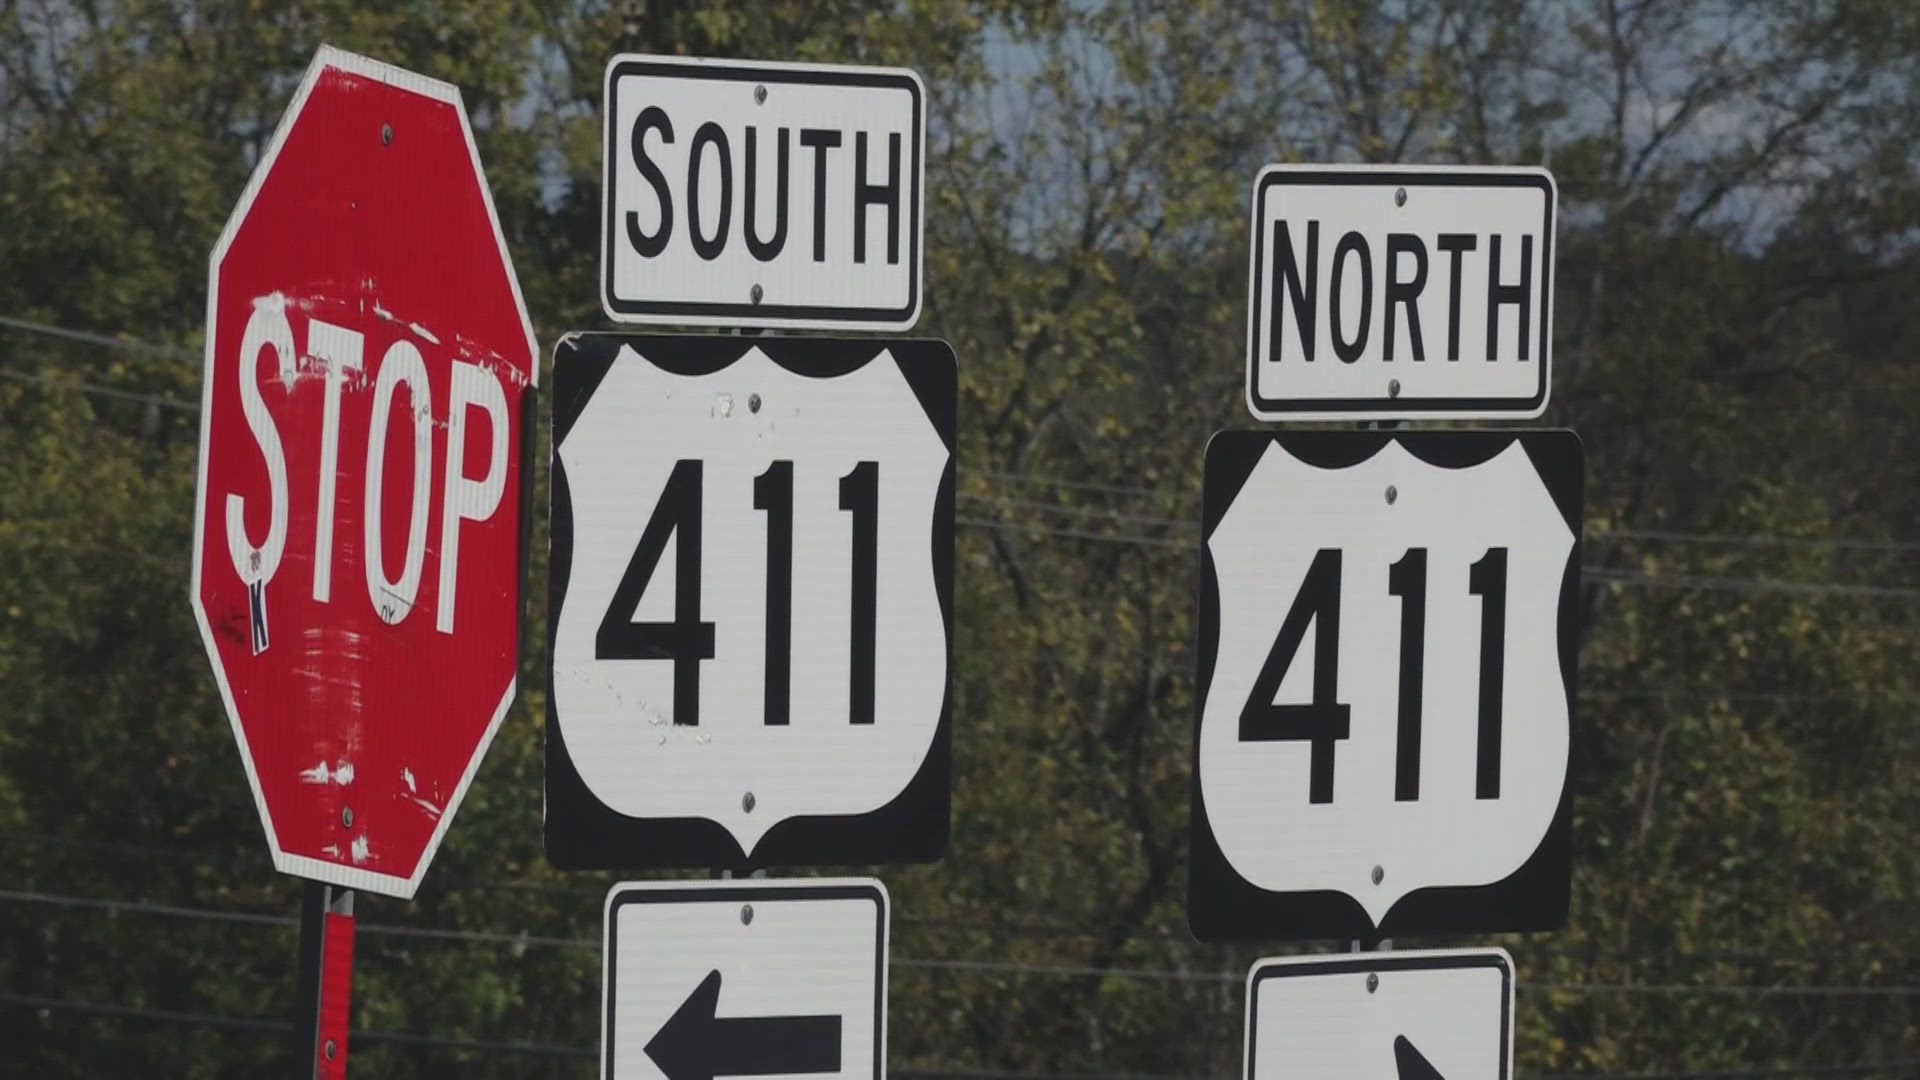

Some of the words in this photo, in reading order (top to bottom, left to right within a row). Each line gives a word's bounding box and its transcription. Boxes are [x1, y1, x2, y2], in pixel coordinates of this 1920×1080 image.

[626, 105, 901, 265] SOUTH
[1269, 219, 1533, 364] NORTH
[226, 295, 509, 634] STOP
[595, 459, 879, 726] 411
[1238, 547, 1508, 804] 411
